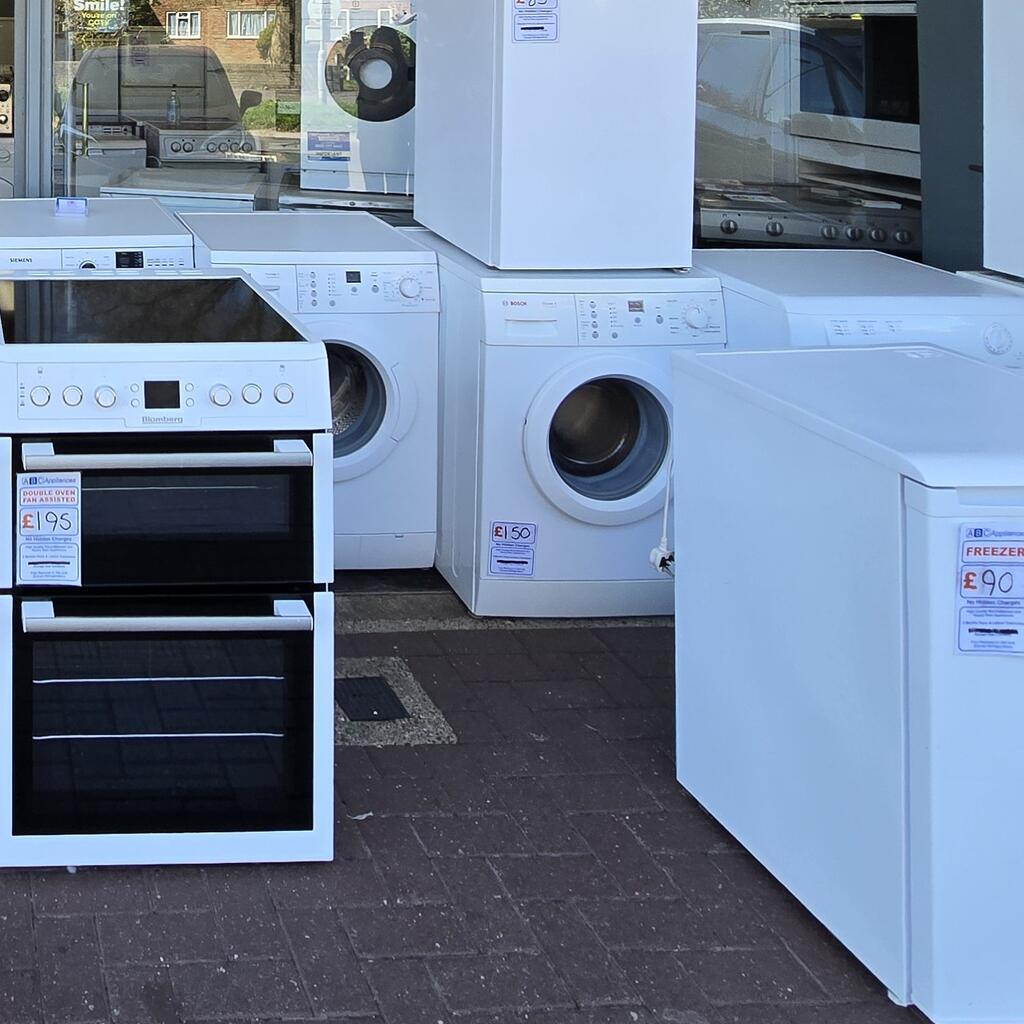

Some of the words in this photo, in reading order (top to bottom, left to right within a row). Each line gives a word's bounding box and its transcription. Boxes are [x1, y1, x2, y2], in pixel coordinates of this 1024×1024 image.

[21, 511, 72, 532] £195
[494, 525, 531, 540] £150
[963, 569, 1014, 596] £90
